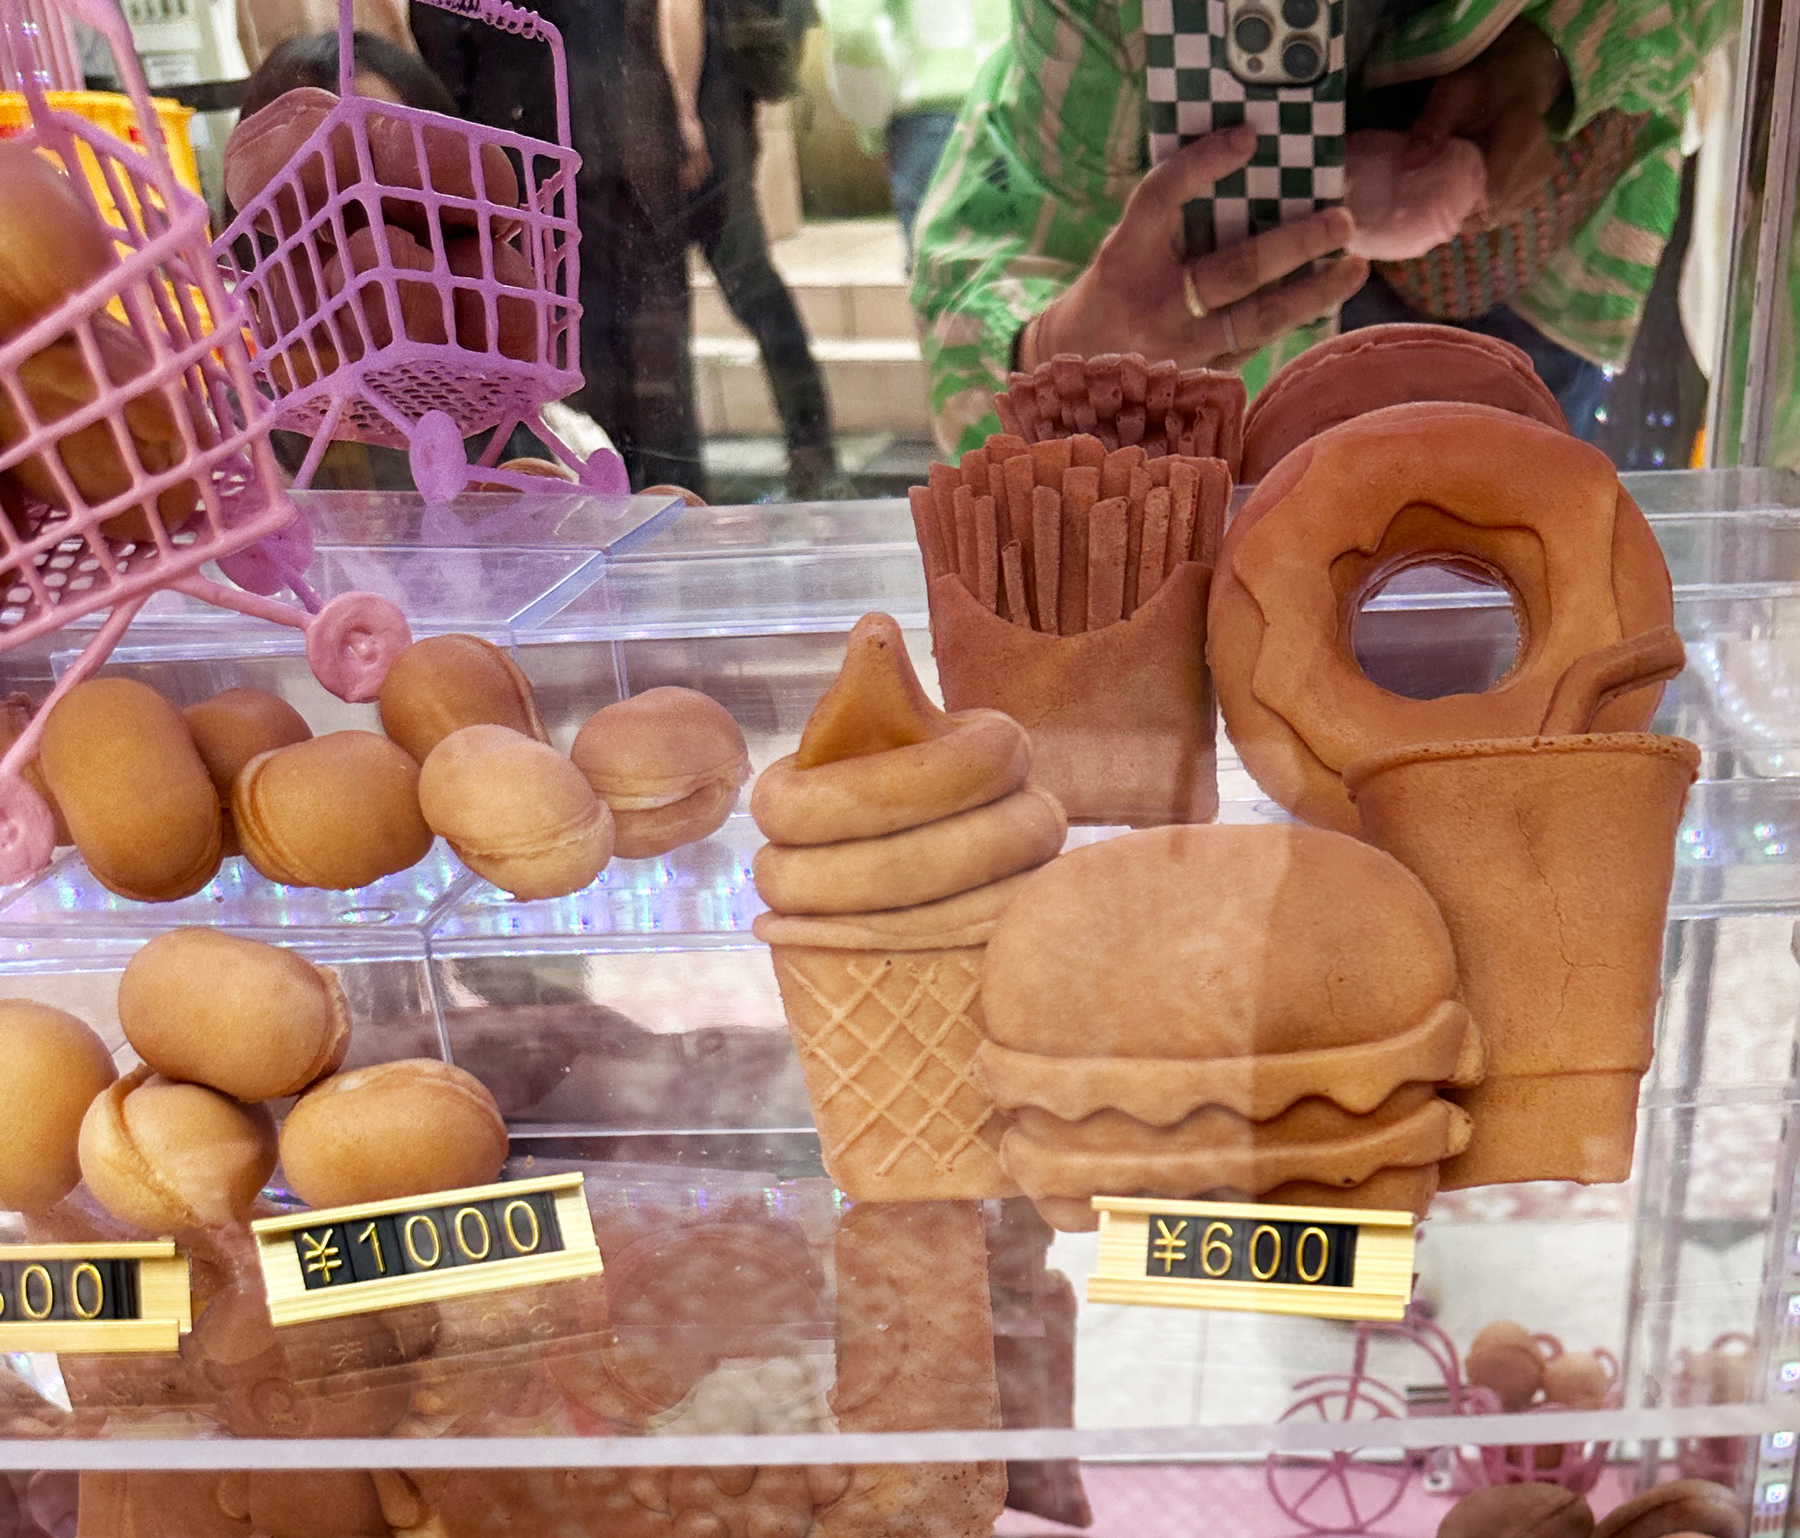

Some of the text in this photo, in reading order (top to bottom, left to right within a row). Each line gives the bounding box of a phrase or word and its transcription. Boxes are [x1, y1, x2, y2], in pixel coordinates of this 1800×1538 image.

[302, 1199, 540, 1283] ¥1000
[1152, 1218, 1330, 1283] ¥600
[0, 1262, 104, 1320] 00
